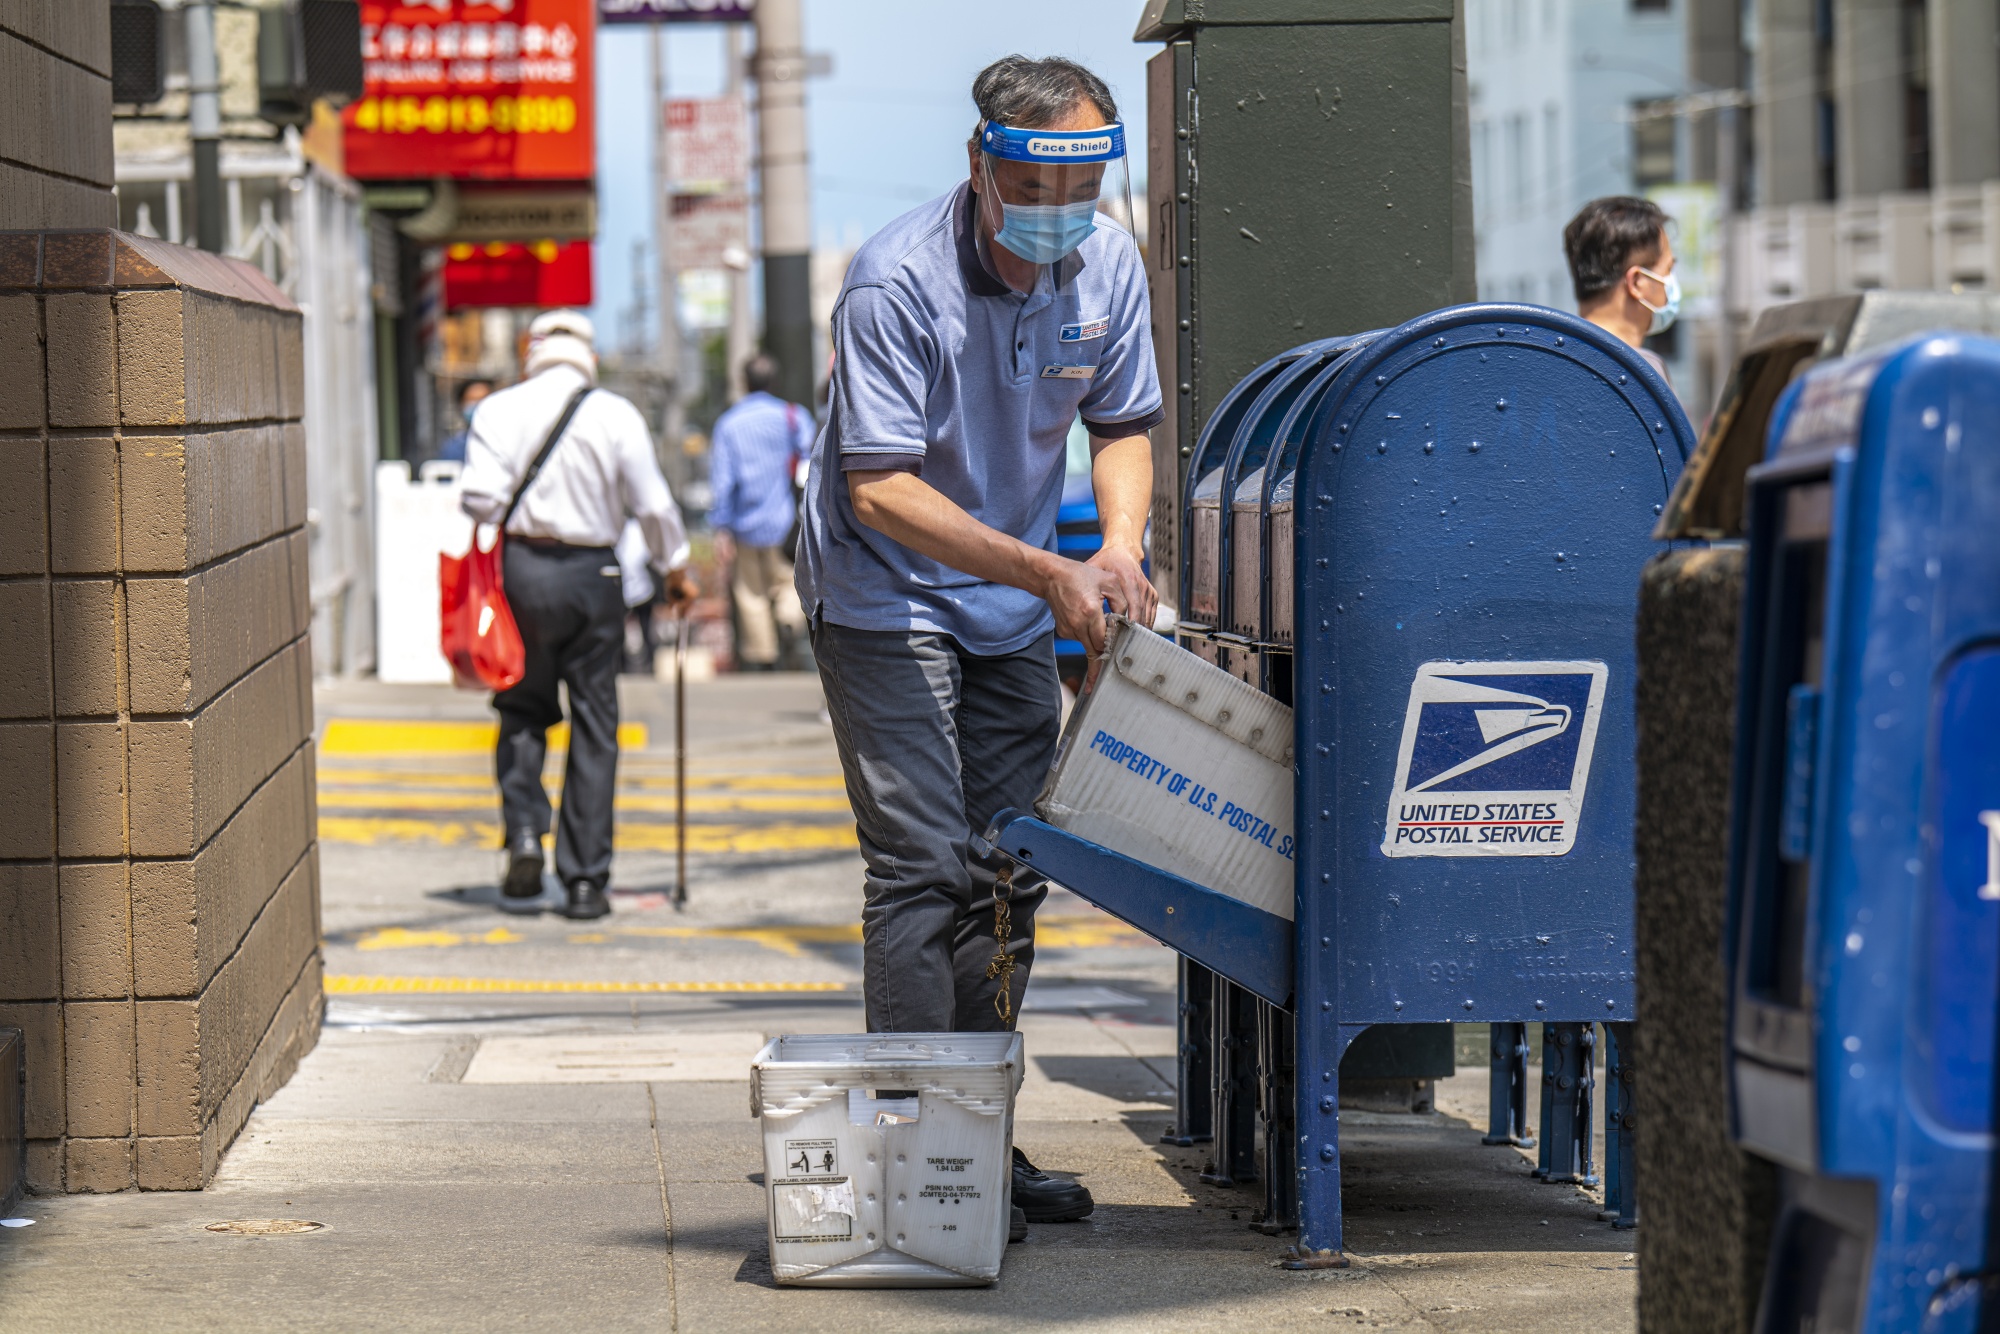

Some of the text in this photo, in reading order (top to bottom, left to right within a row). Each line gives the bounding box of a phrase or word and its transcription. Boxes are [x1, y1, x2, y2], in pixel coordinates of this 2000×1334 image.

[1033, 142, 1066, 152] Face
[1071, 141, 1108, 152] Shield
[1089, 730, 1172, 786] PROPERTY
[1167, 773, 1192, 797] OF
[1188, 784, 1219, 816] U.S.
[1218, 801, 1278, 849] POSTAL
[1399, 803, 1557, 821] UNITED STATES
[1395, 827, 1473, 844] POSTAL
[926, 1157, 945, 1165] TARE
